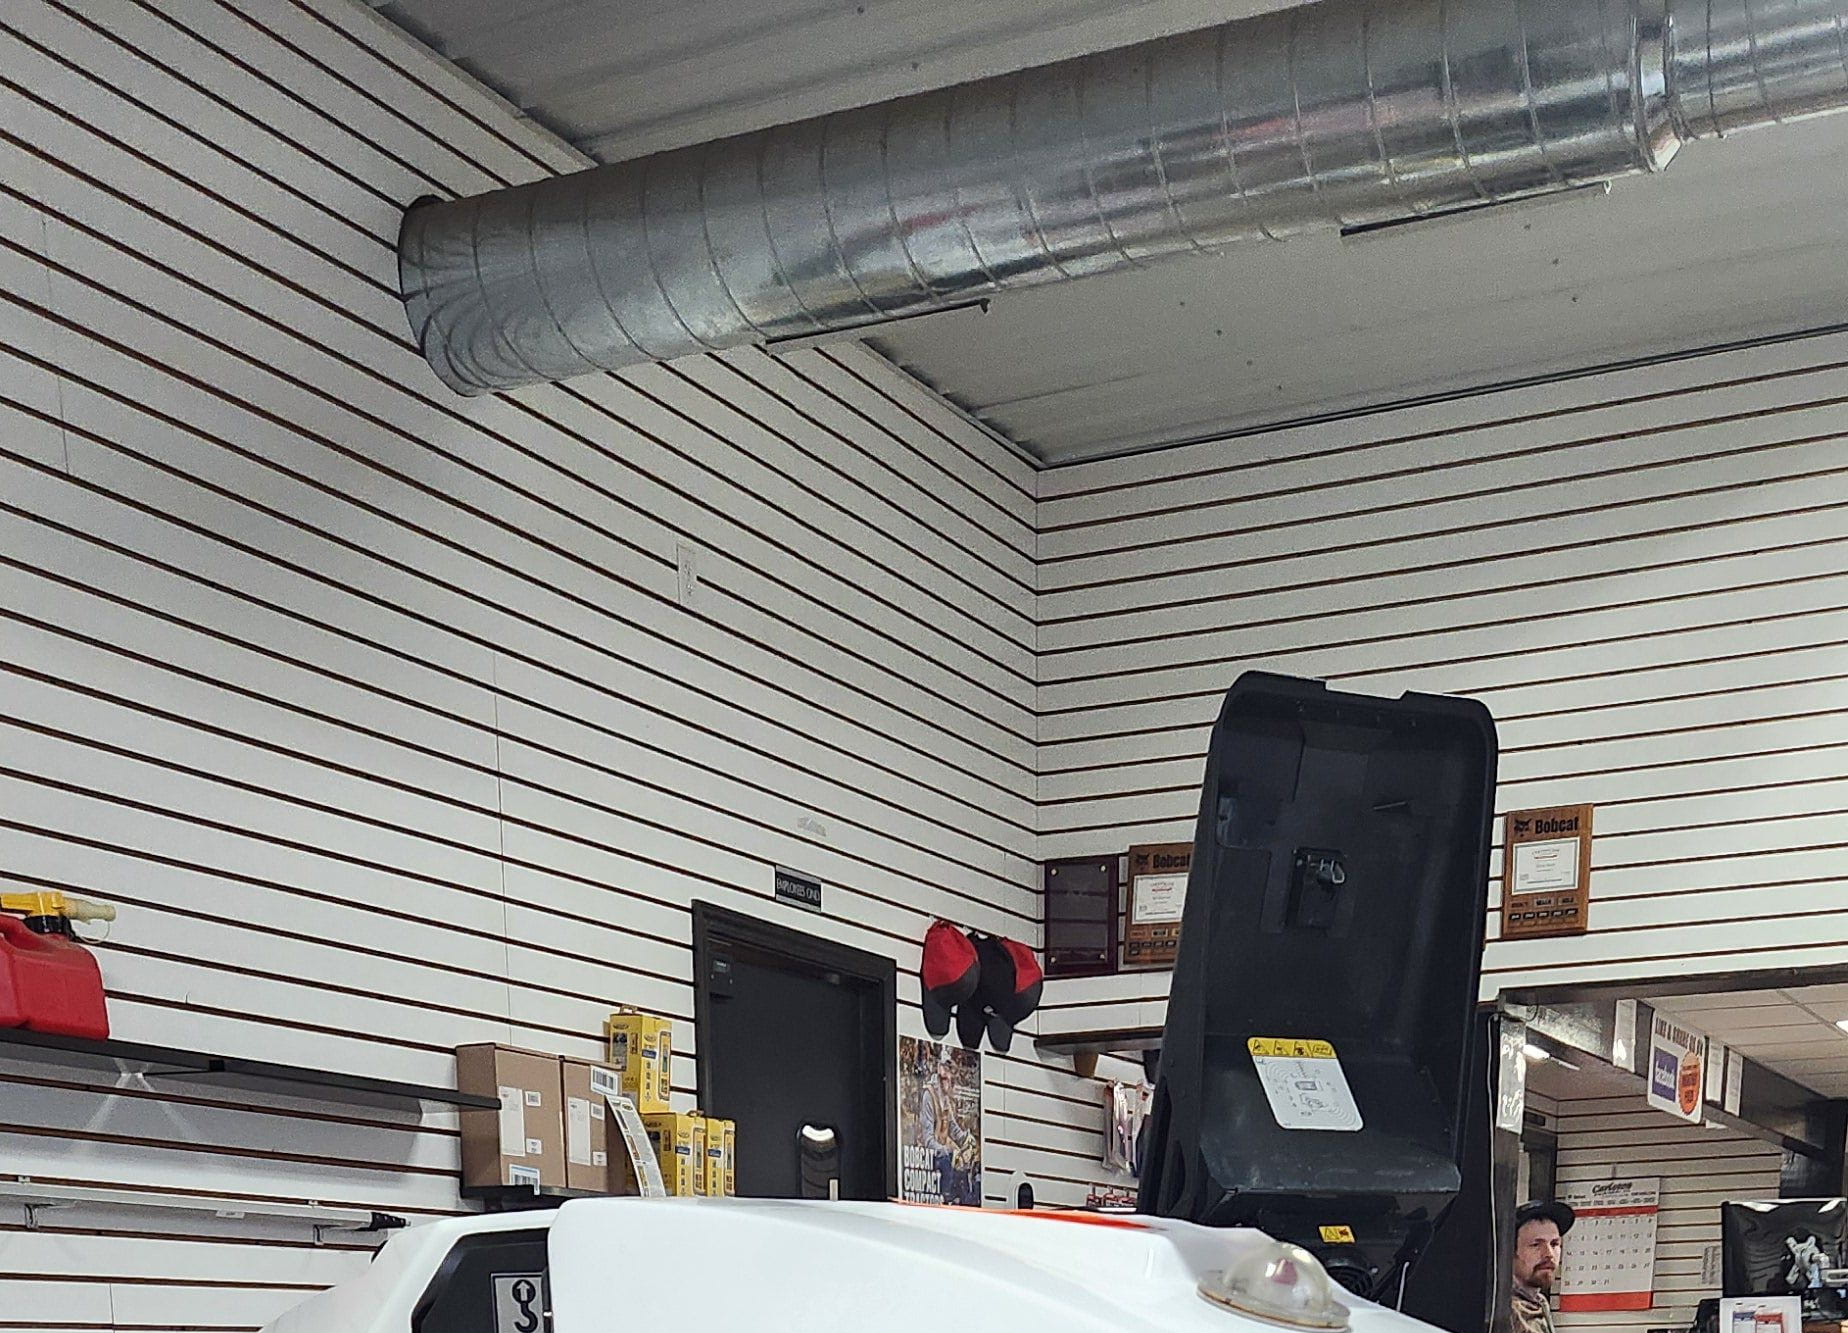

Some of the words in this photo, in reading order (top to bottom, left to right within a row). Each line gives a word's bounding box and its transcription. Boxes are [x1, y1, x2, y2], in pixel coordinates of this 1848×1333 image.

[1535, 816, 1579, 834] Bobcat
[903, 1144, 935, 1169] BOBCAT
[903, 1168, 942, 1193] COMPACT
